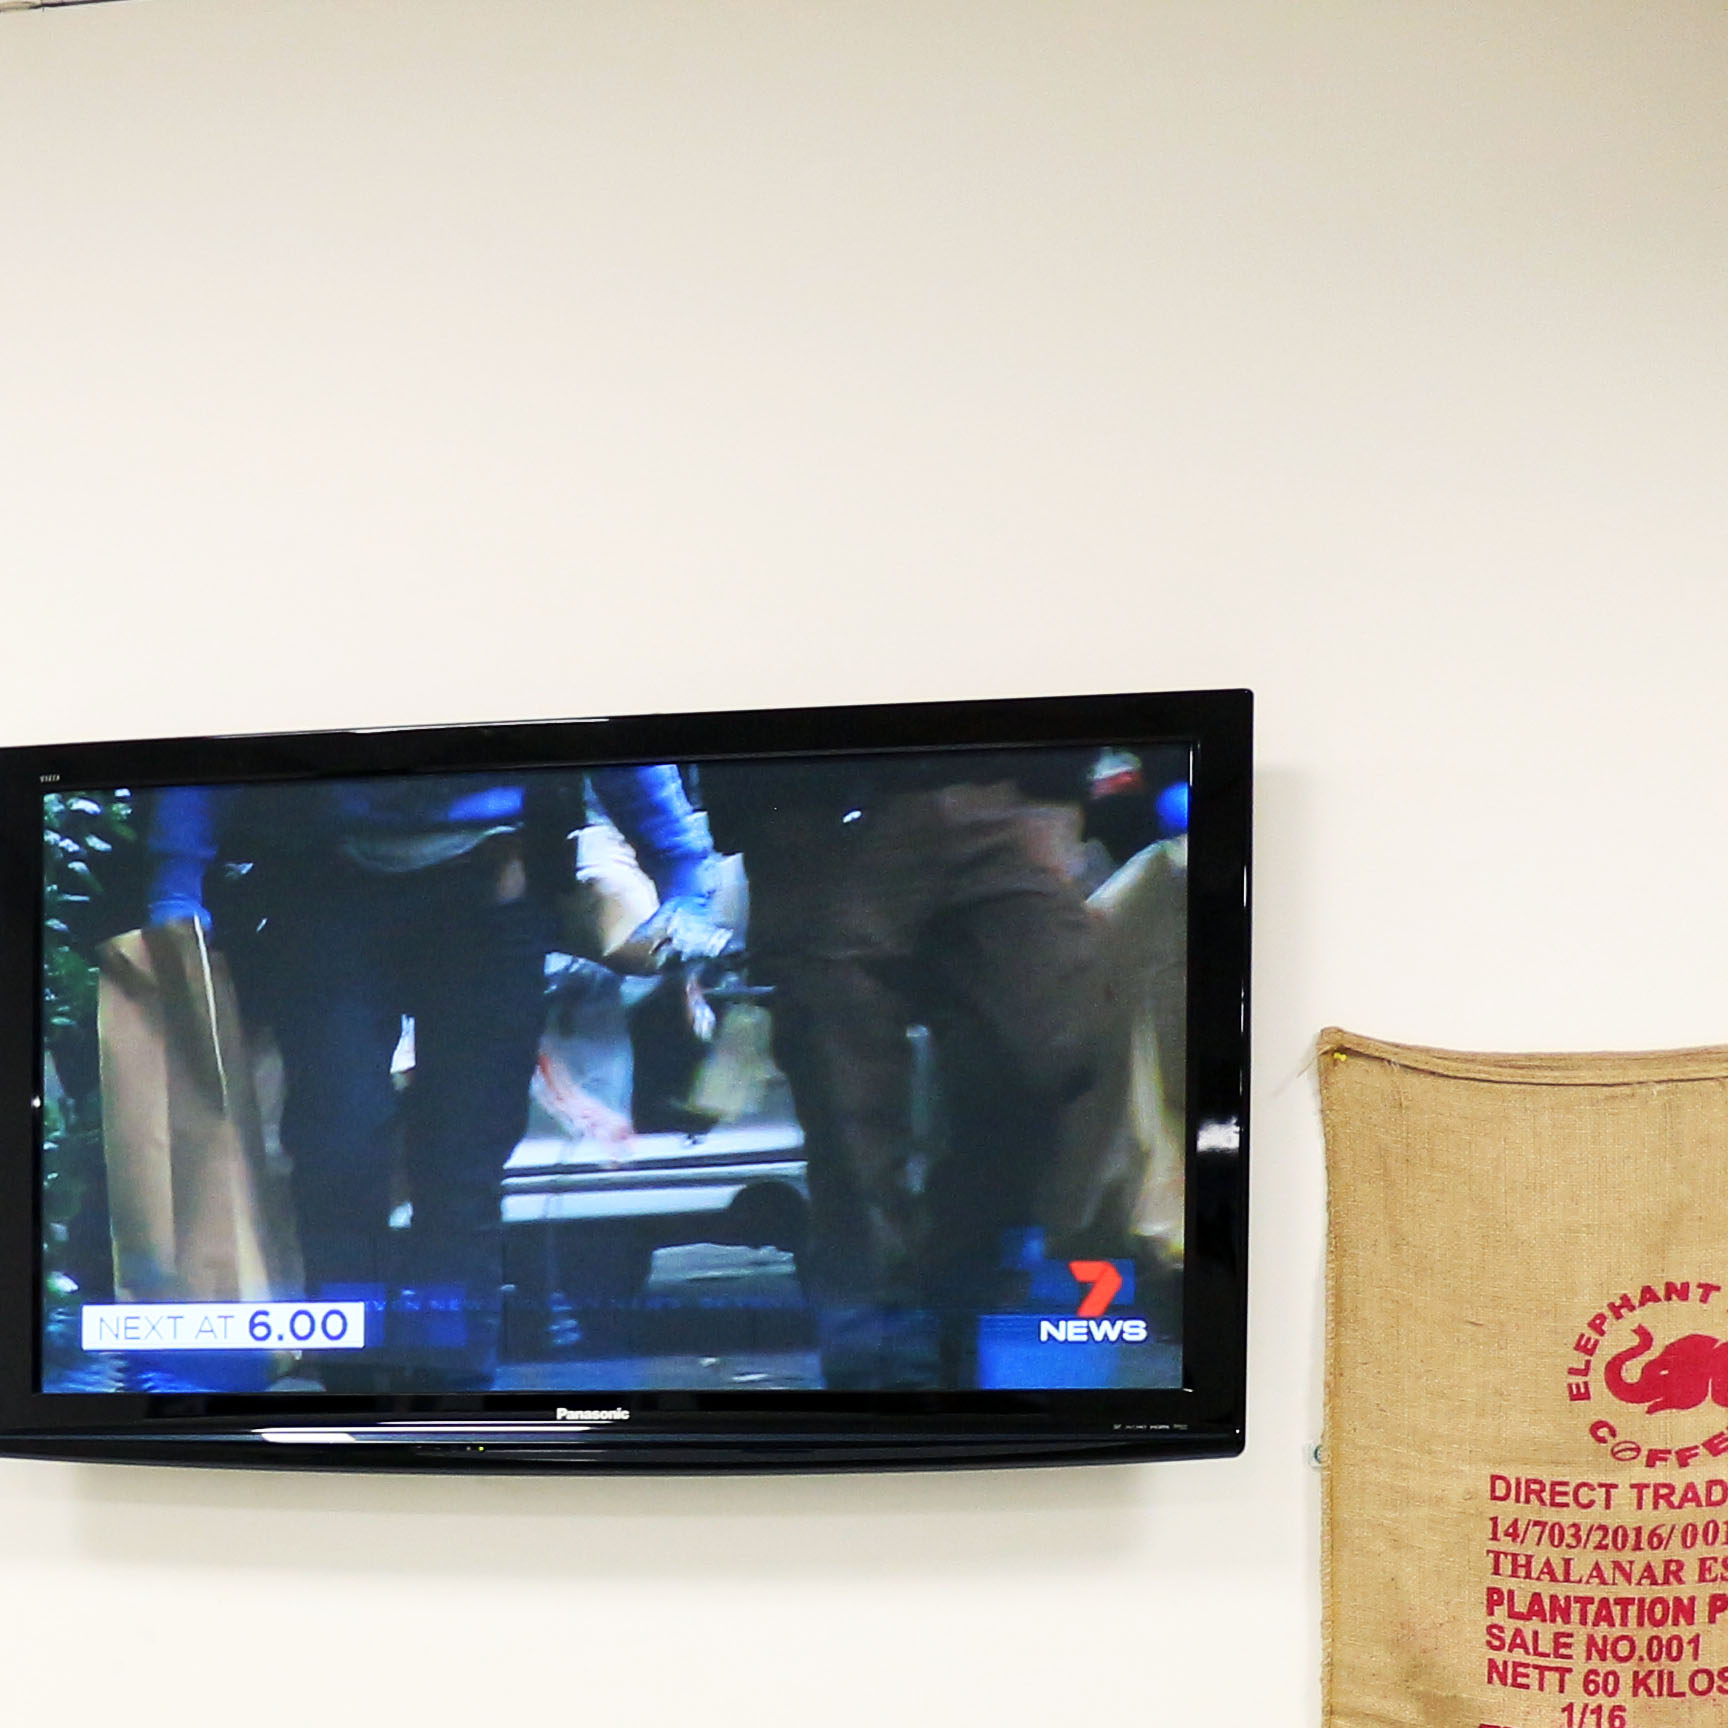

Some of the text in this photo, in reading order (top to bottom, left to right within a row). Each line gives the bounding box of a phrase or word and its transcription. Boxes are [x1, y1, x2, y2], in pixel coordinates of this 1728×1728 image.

[1068, 1260, 1123, 1318] 7
[98, 1308, 349, 1343] NEXT AT 6.00
[1039, 1319, 1148, 1343] NEWS
[1567, 1281, 1722, 1402] ELEPHANT
[555, 1406, 631, 1421] Panasonic
[1489, 1474, 1619, 1510] DIRECT
[1486, 1549, 1686, 1587] THALANAR
[1485, 1586, 1697, 1628] PLANTATION
[1485, 1623, 1702, 1664] SALE NO.001
[1486, 1658, 1574, 1695] NETT
[1582, 1668, 1621, 1698] 60
